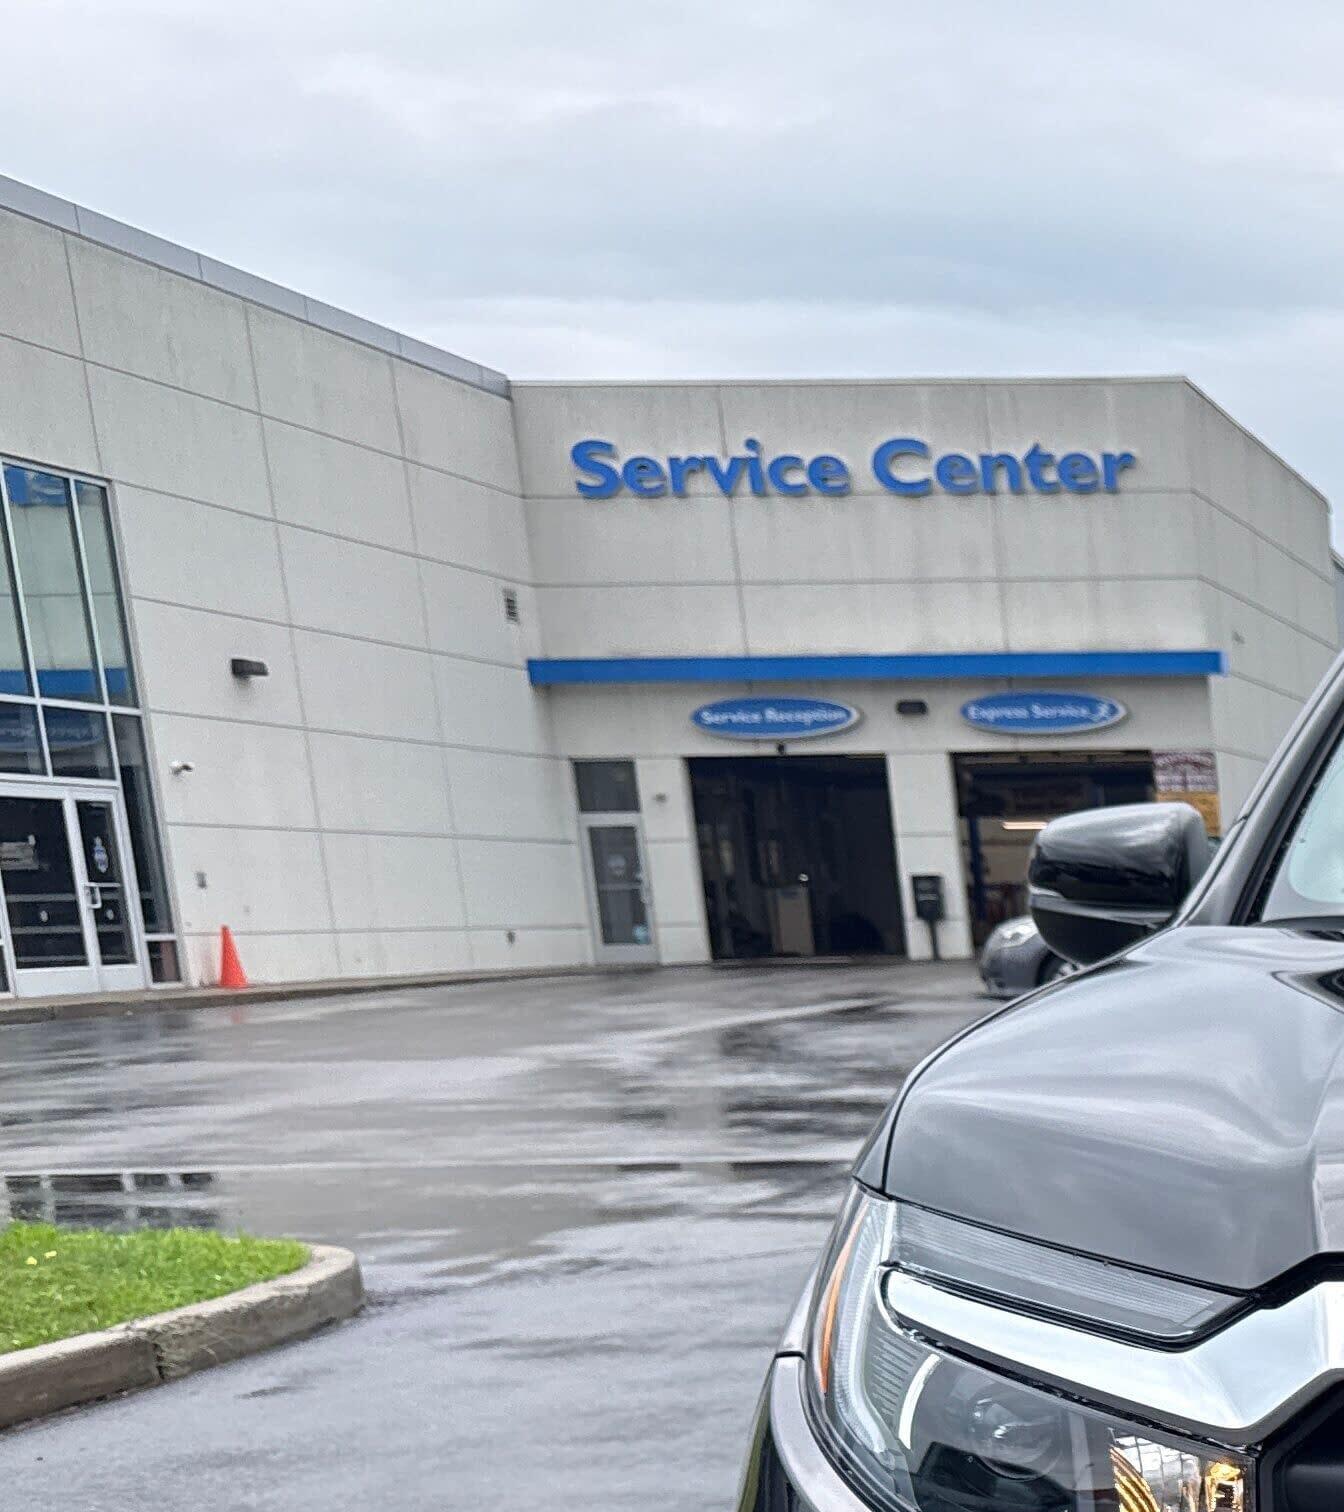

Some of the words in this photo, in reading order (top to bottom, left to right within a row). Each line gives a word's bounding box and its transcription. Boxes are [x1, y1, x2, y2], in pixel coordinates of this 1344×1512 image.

[571, 438, 851, 498] Service
[872, 438, 1136, 496] Center
[701, 710, 762, 725] Service
[764, 707, 847, 726] Reception
[967, 704, 1029, 722] Express
[1031, 703, 1090, 719] Service
